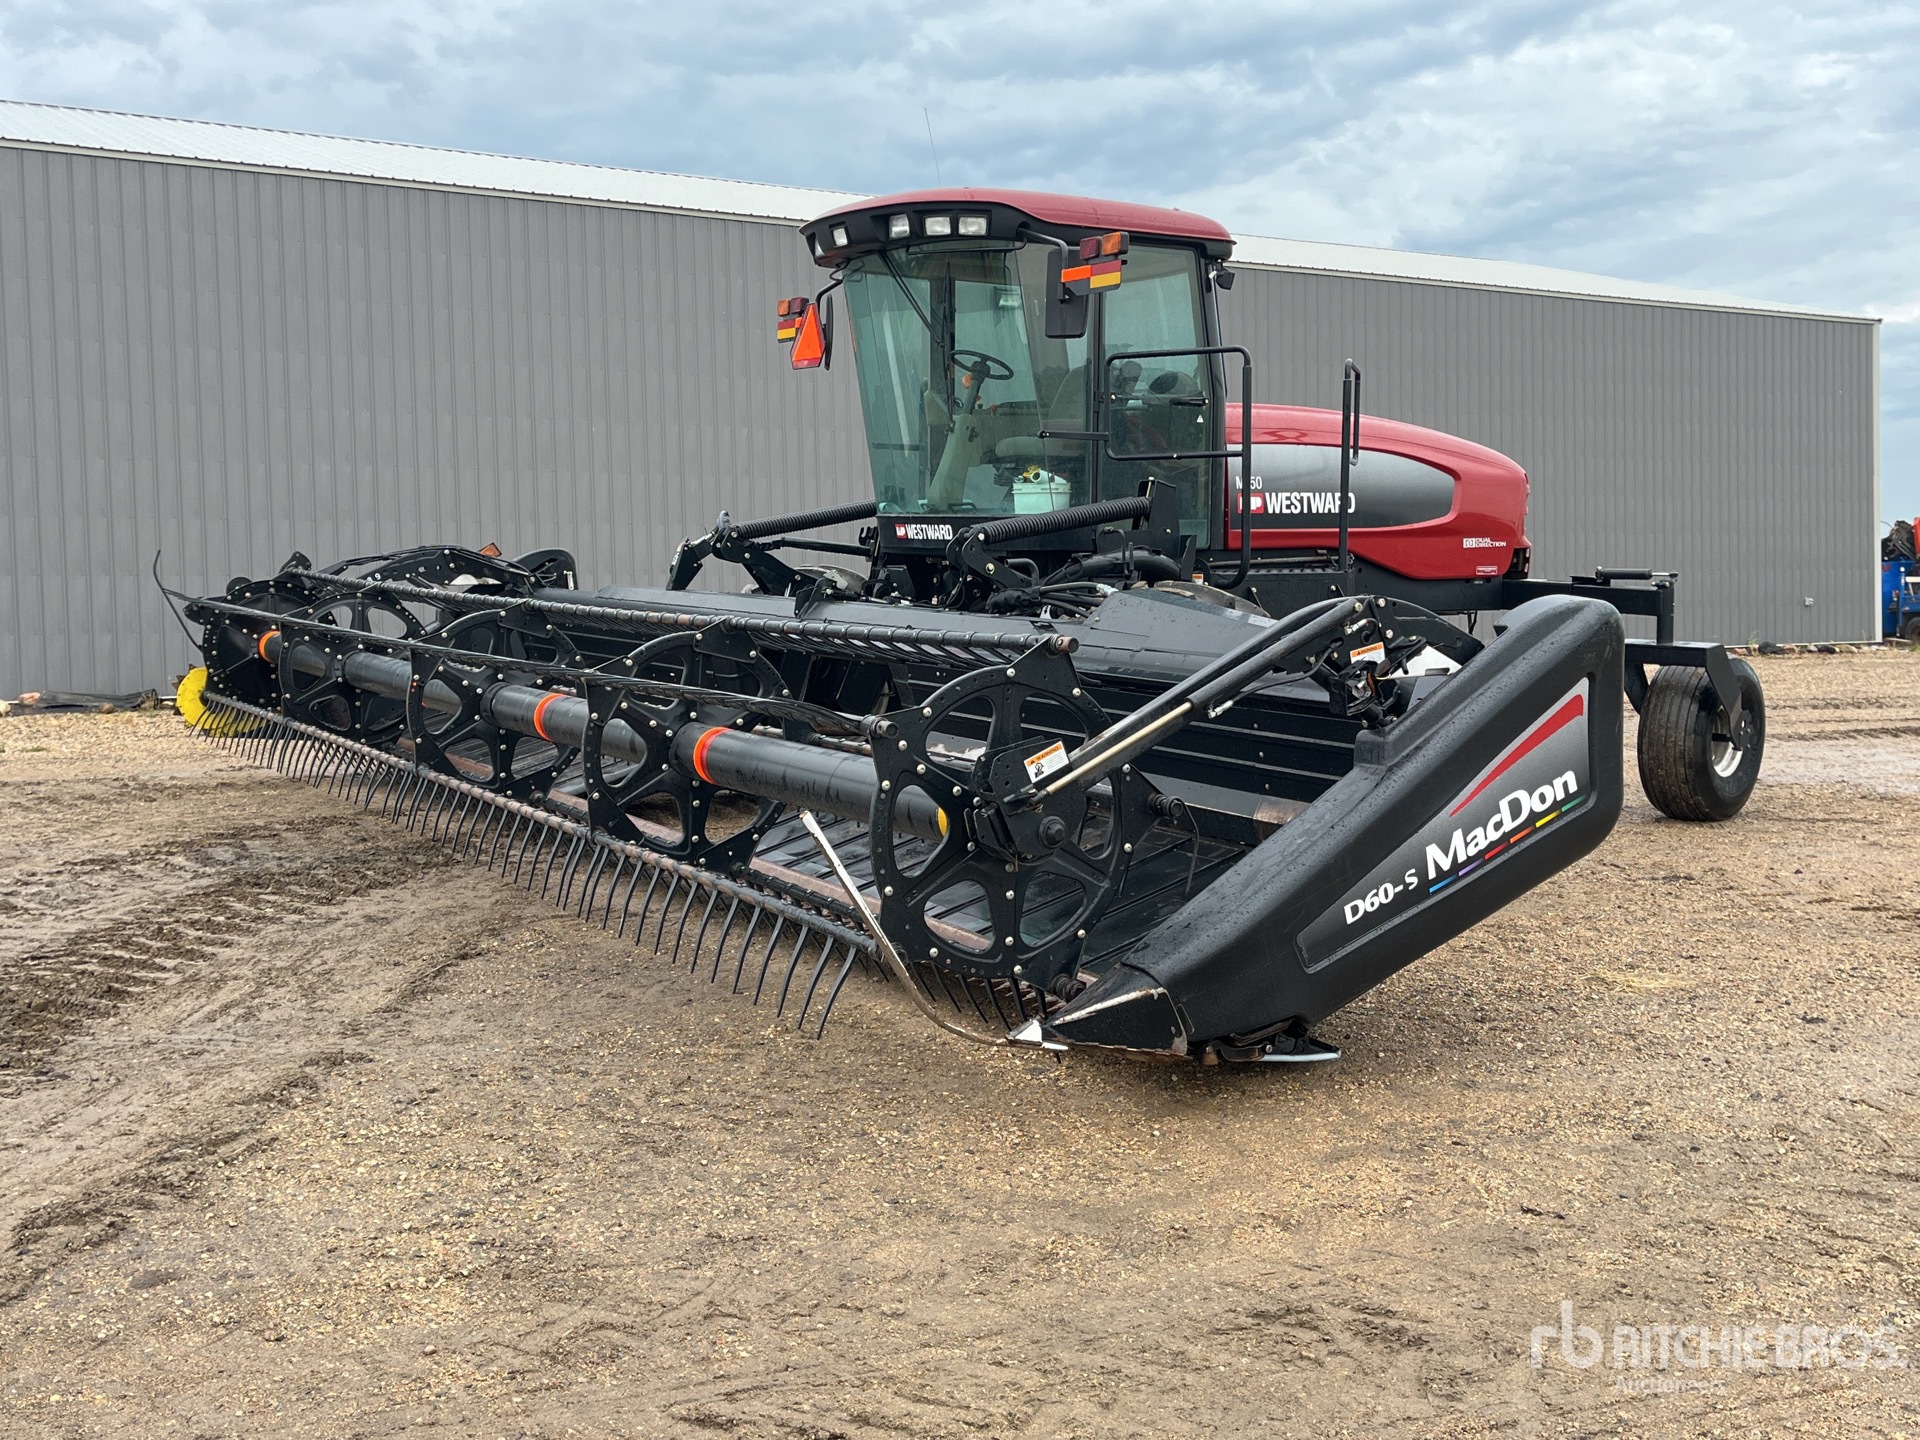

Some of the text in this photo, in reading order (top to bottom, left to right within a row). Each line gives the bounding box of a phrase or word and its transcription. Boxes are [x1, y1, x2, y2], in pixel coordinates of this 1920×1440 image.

[1235, 476, 1263, 490] M50
[905, 523, 954, 540] WESTWARD
[1425, 770, 1578, 881] MacDon
